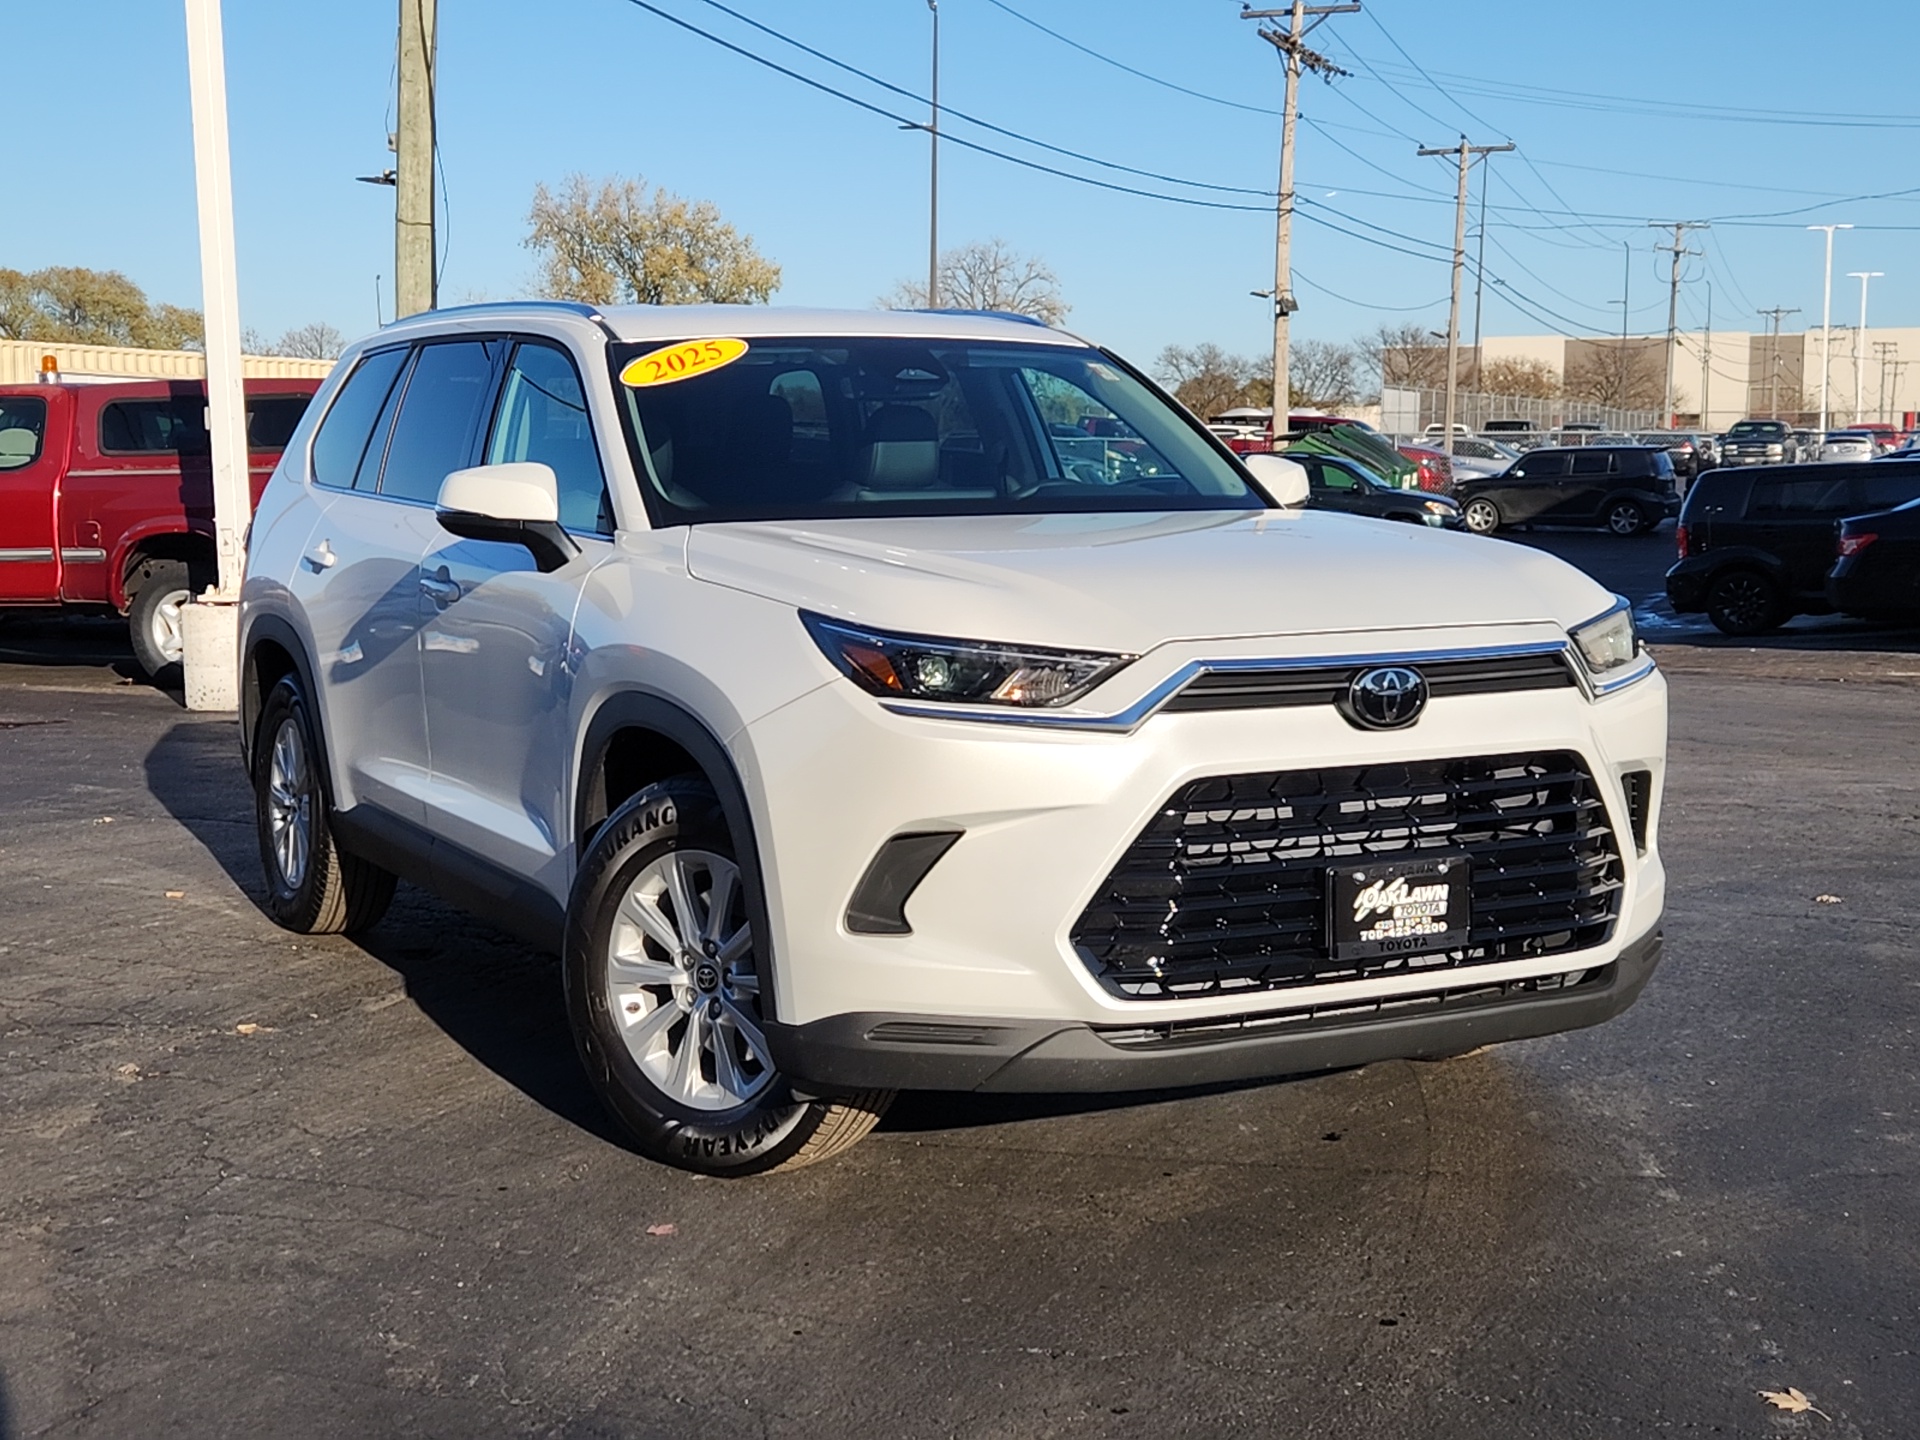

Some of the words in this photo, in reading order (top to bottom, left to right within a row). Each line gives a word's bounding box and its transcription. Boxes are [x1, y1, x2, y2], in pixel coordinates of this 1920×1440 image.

[645, 341, 722, 381] 2025
[1401, 903, 1440, 916] TOYOTA
[1378, 937, 1428, 952] TOYOTA
